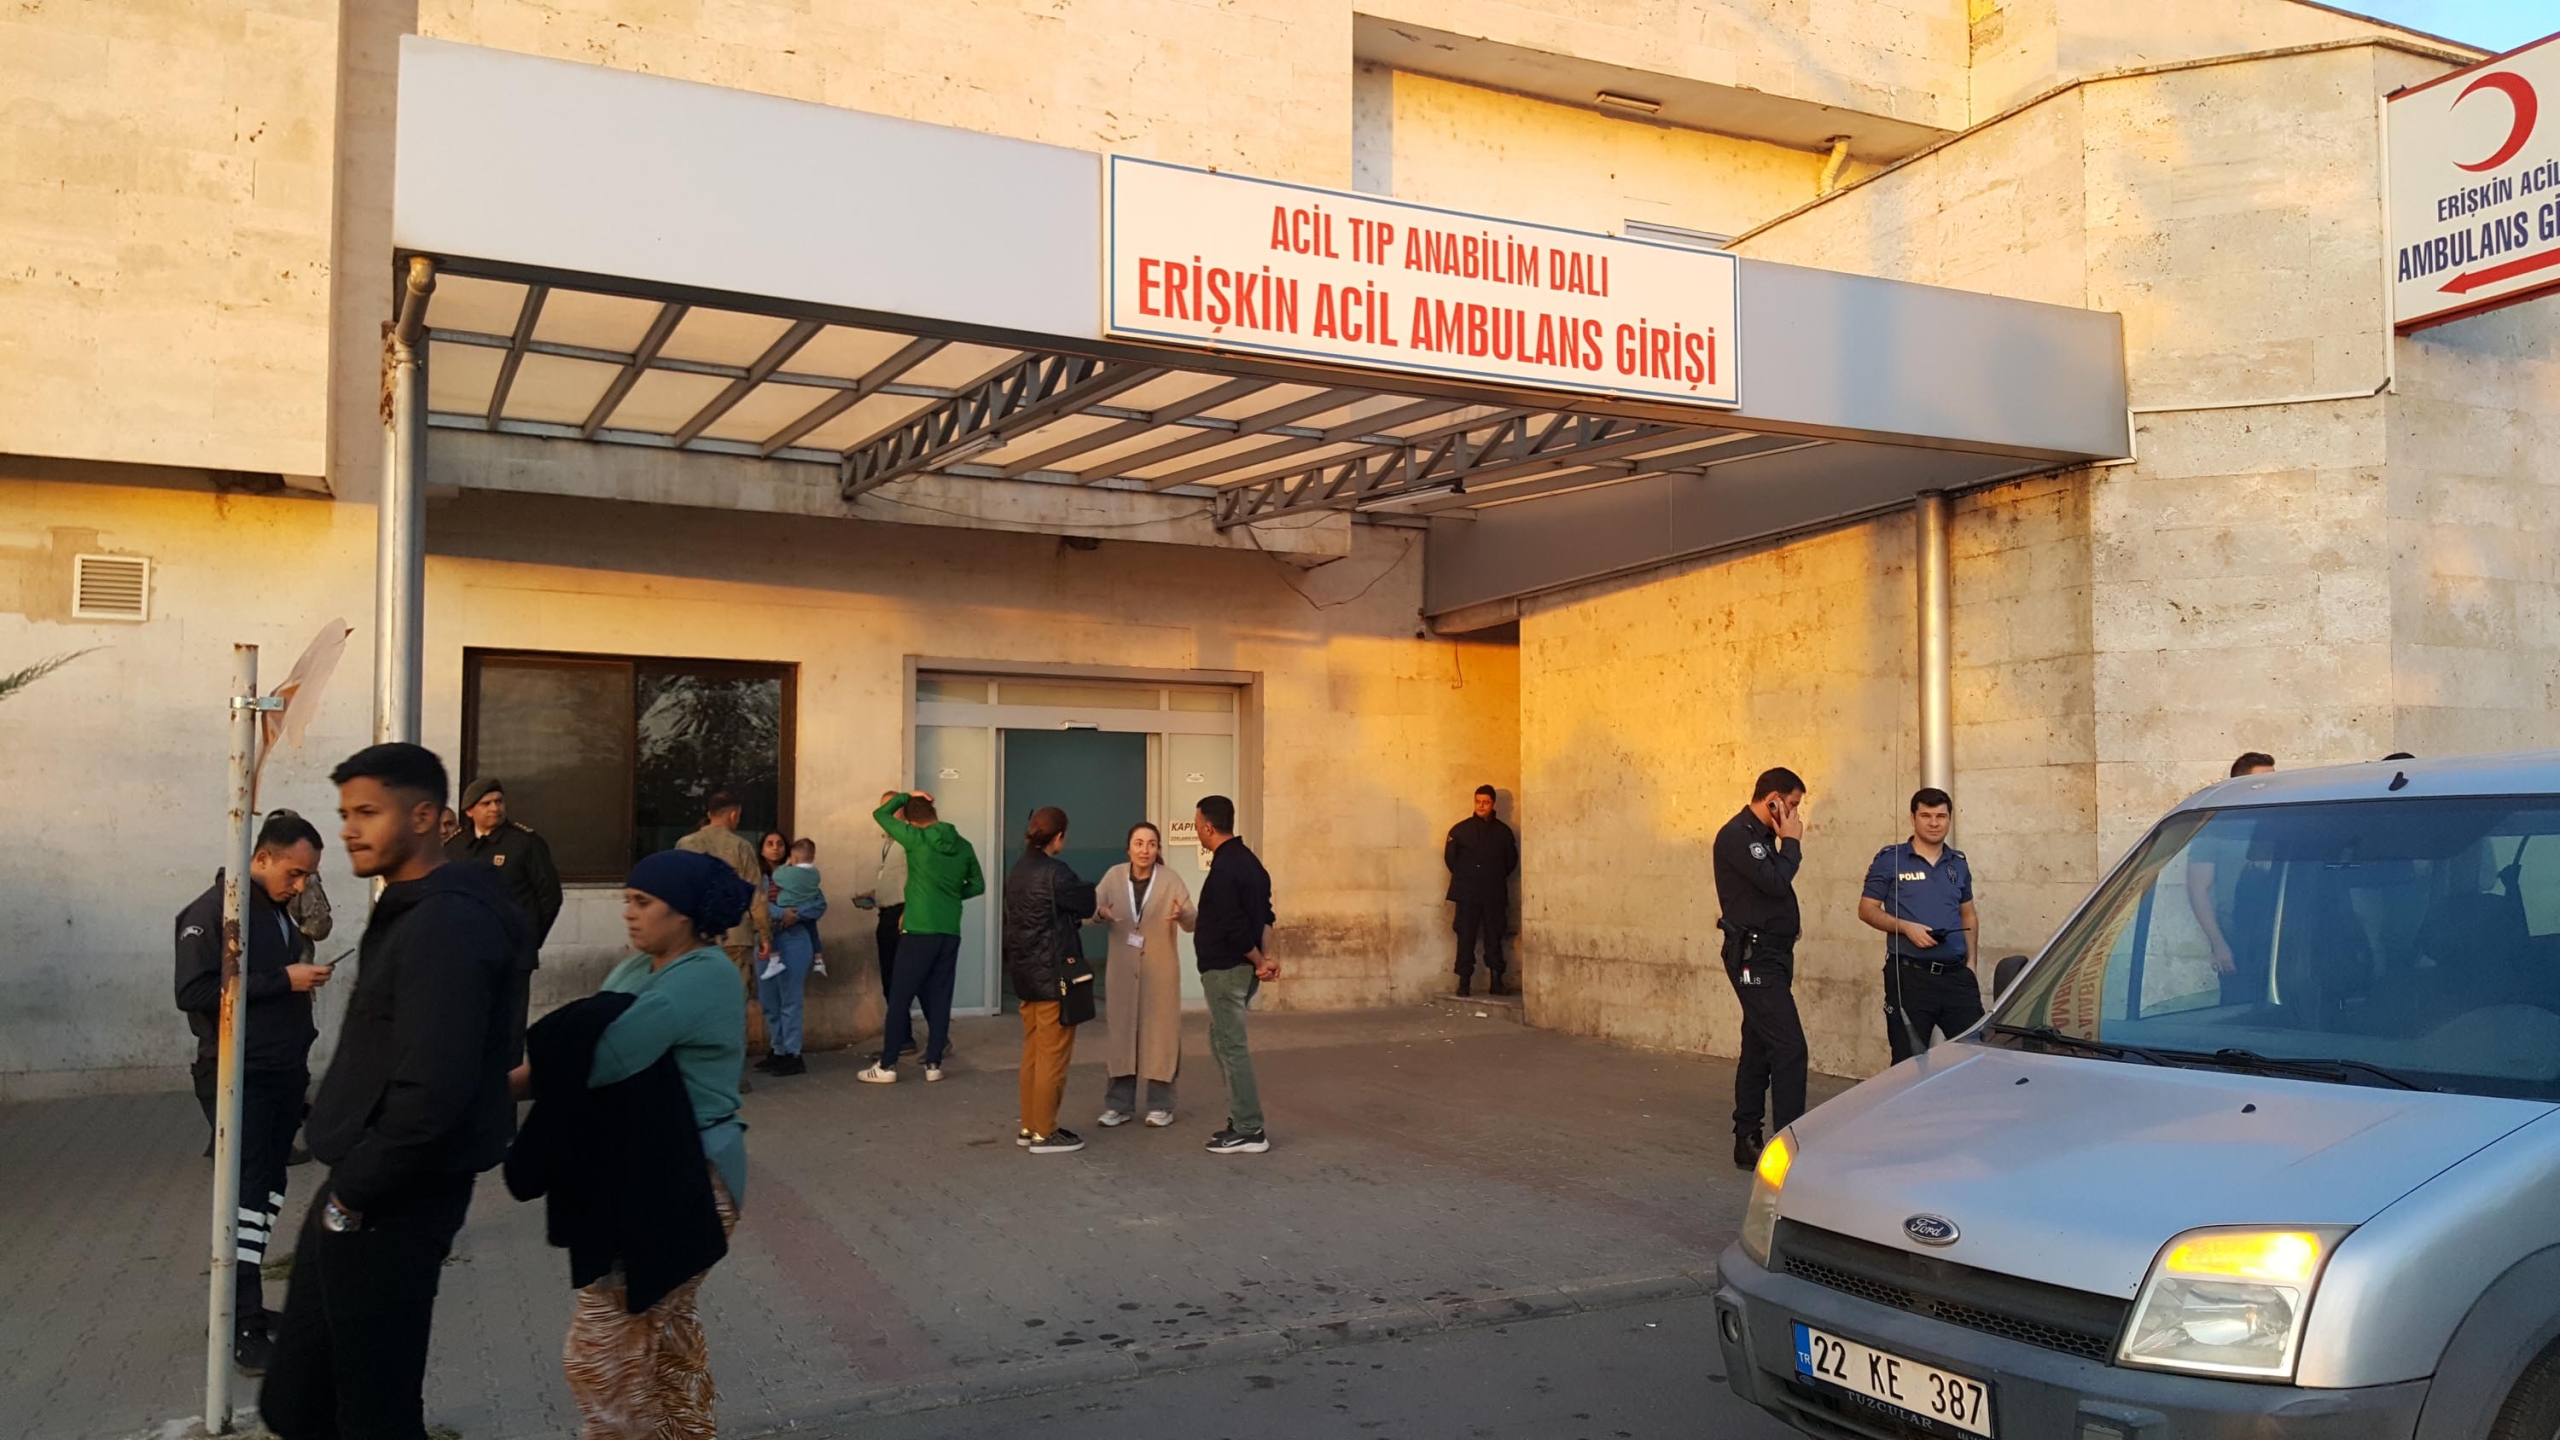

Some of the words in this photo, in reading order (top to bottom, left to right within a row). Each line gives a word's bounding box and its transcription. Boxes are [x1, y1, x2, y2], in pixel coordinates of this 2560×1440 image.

[2437, 177, 2513, 222] ERİŞKİN
[2520, 159, 2560, 196] ACİL
[1270, 204, 1339, 259] ACİL
[1348, 217, 1395, 266] TIP
[1404, 226, 1540, 288] ANABİLİM
[1550, 248, 1609, 298] DALI
[2397, 211, 2529, 283] AMBULANS
[1138, 255, 1299, 334] ERİŞKİN
[1312, 280, 1398, 347] ACİL
[1410, 296, 1604, 372] AMBULANS
[1615, 318, 1717, 392] GİRİŞİ
[1911, 1218, 1944, 1237] Ford
[1798, 1351, 1811, 1366] TR
[1814, 1335, 1848, 1380] 22
[1868, 1352, 1904, 1401] KE
[1928, 1373, 1983, 1426] 387
[1846, 1390, 1934, 1431] TUZCULAR
